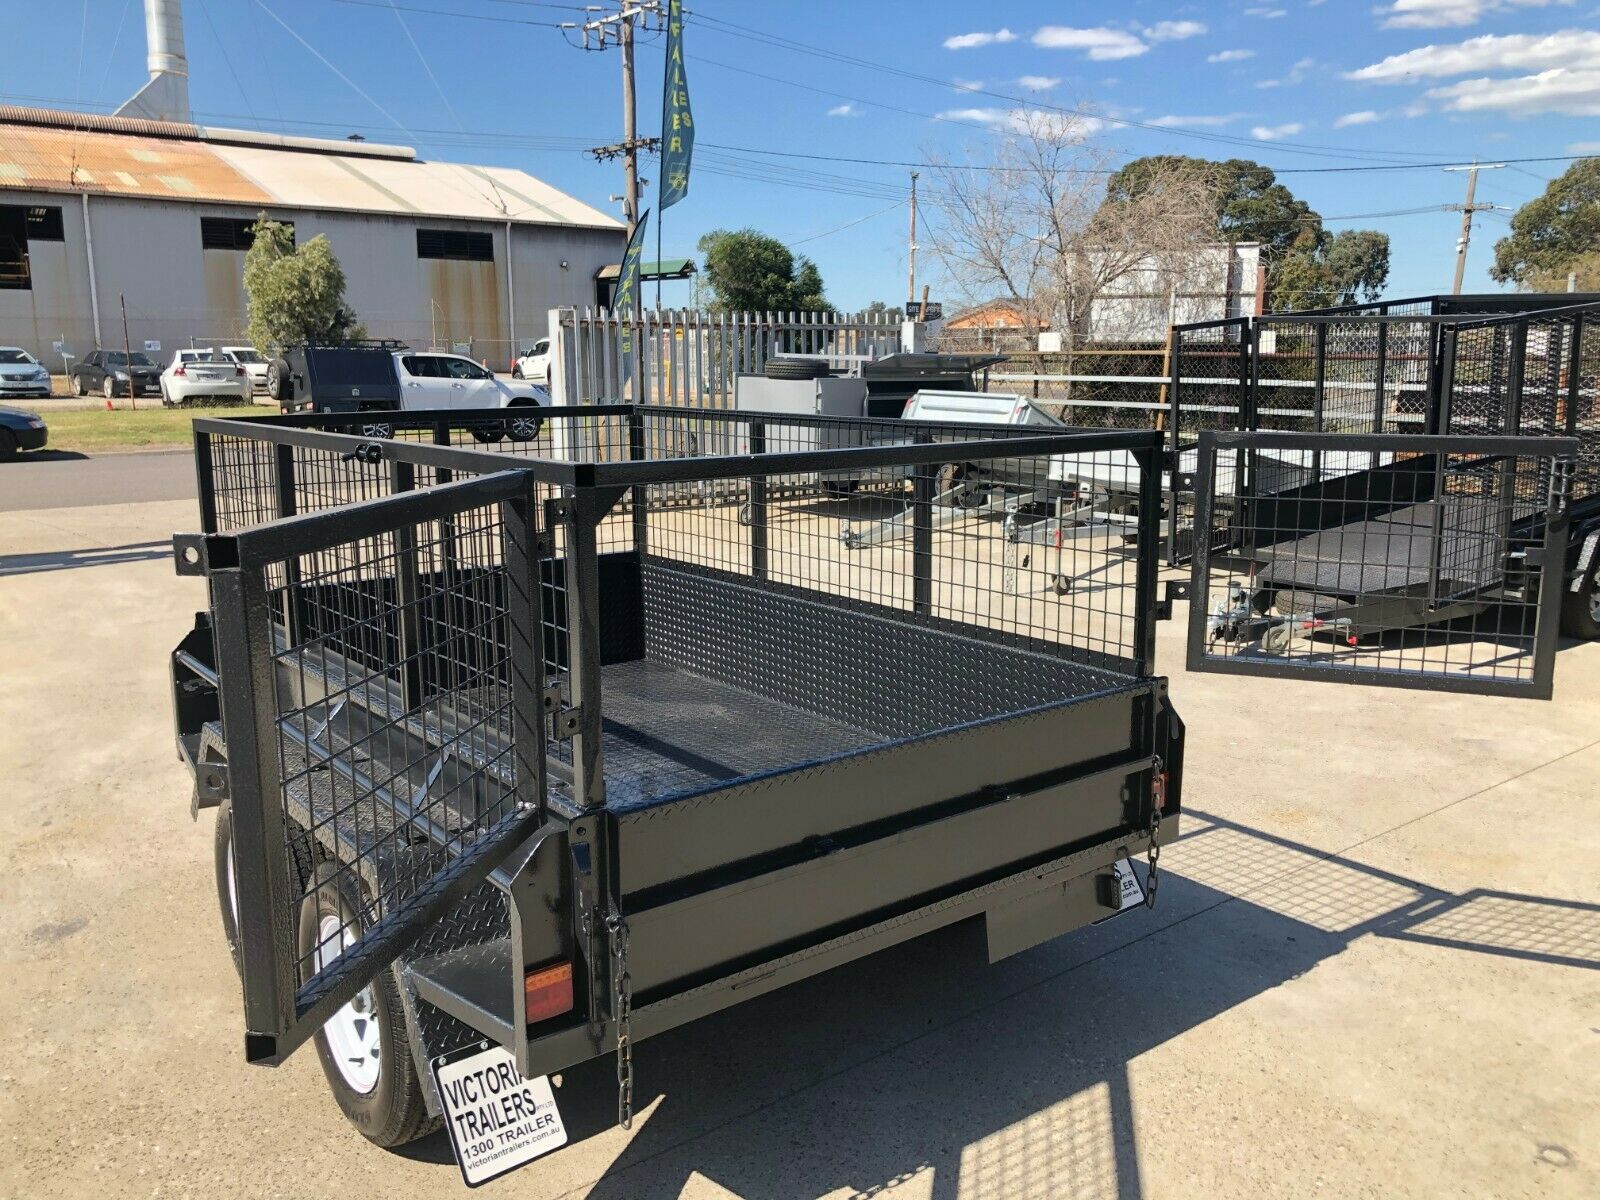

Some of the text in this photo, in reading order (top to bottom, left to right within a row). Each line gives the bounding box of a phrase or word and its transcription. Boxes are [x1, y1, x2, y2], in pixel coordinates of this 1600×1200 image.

[444, 1059, 522, 1109] VICTORI
[455, 1088, 536, 1142] TRAILERS
[463, 1113, 556, 1160] 1300 TRAILER
[466, 1126, 560, 1170] victoriantrailers.com.au
